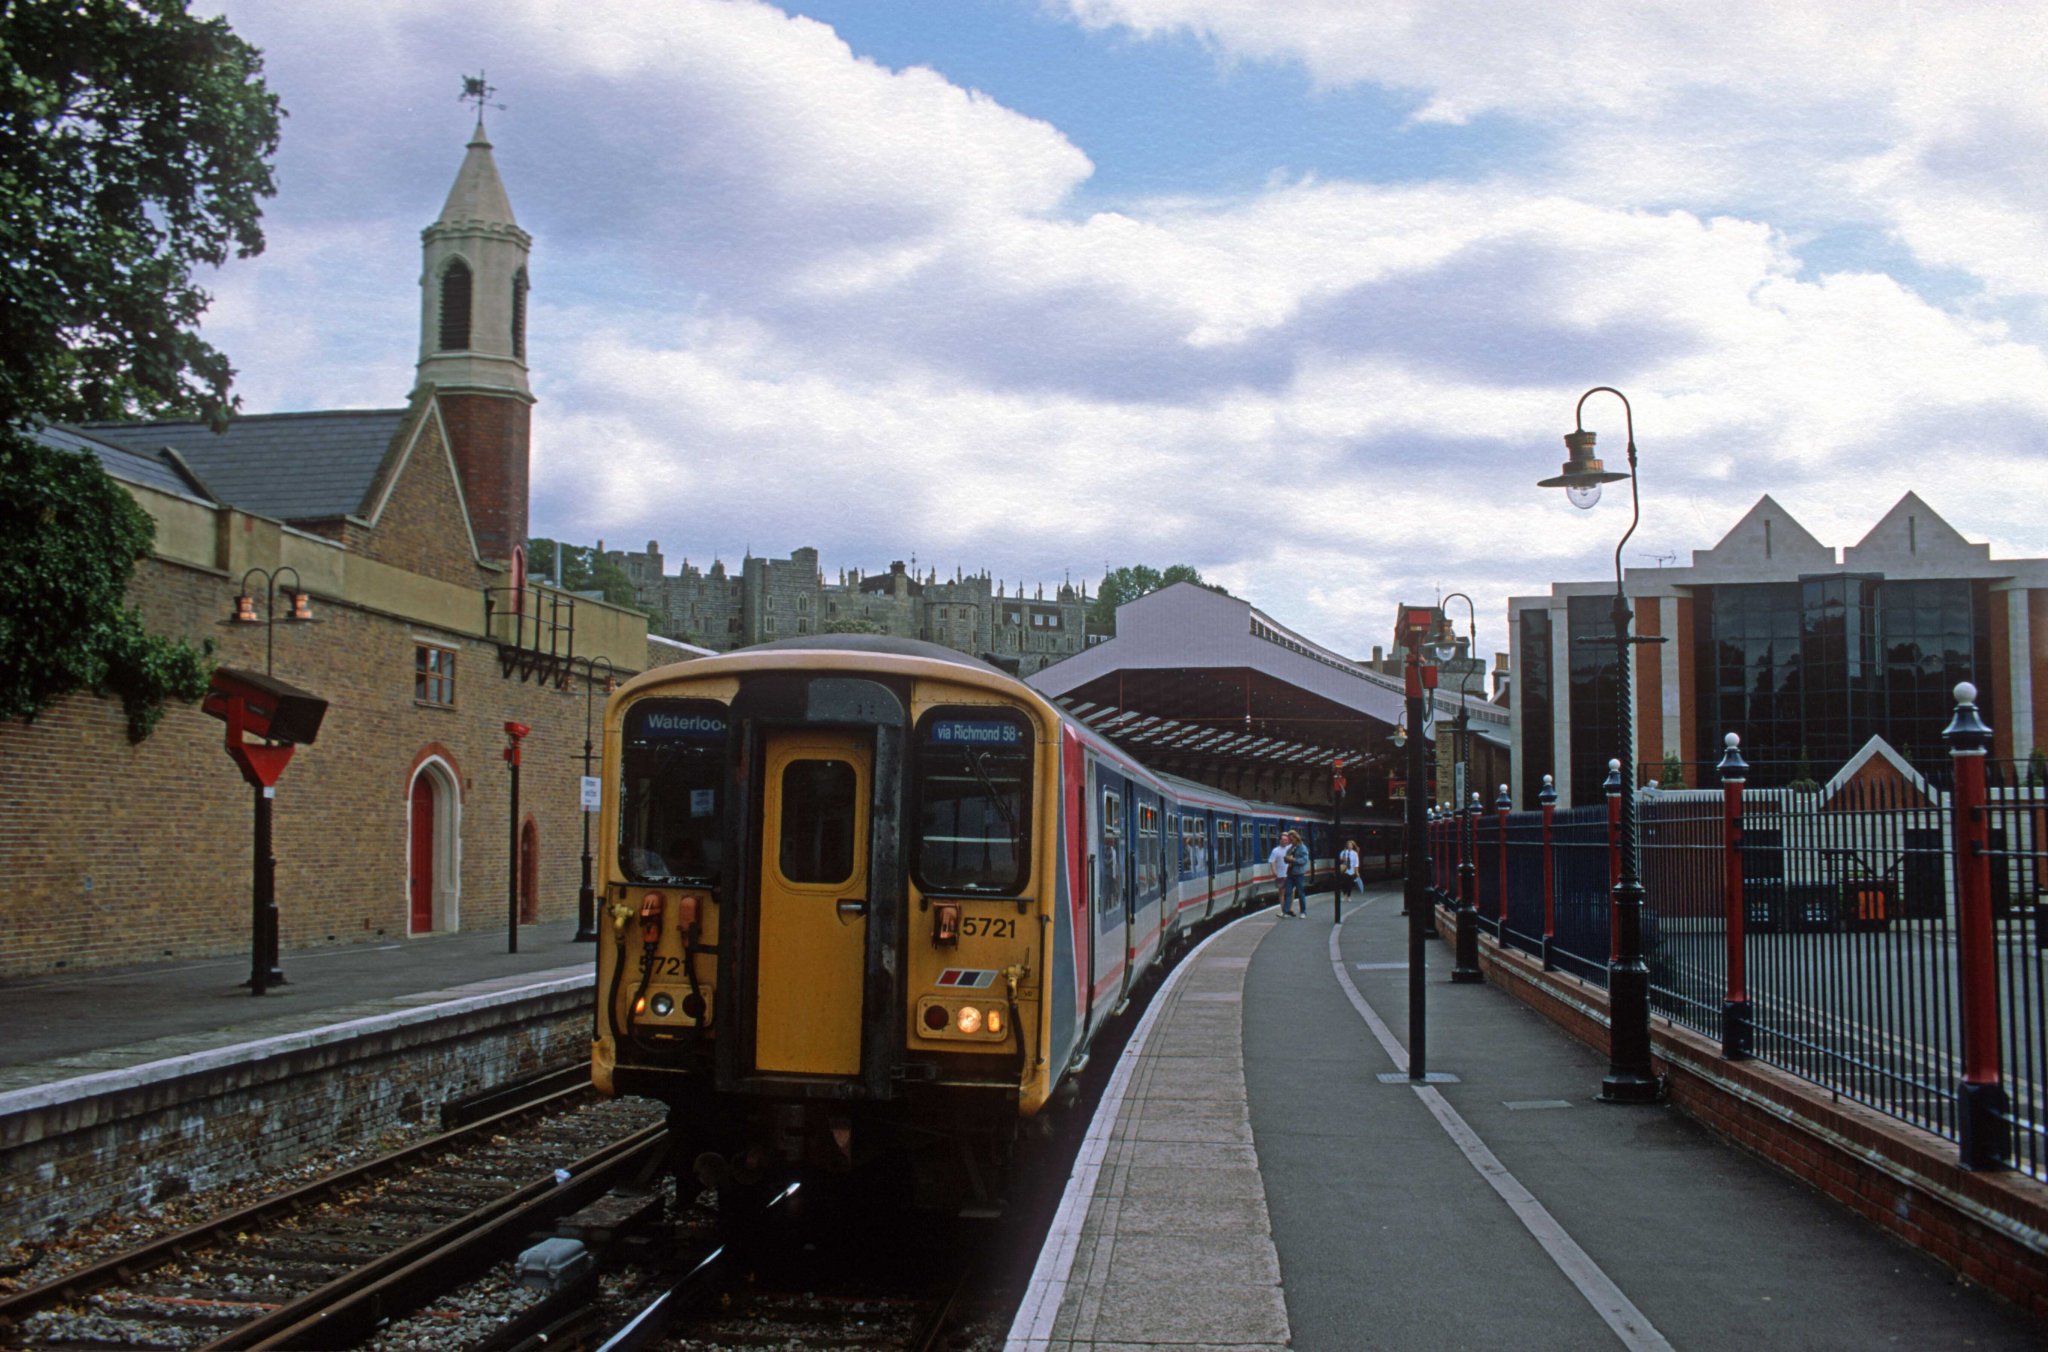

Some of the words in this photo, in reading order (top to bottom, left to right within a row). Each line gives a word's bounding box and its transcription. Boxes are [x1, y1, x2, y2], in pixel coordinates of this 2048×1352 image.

[648, 713, 722, 731] Waterloo
[937, 724, 951, 740] via
[954, 724, 1000, 741] Richmond
[1003, 725, 1016, 741] 58
[963, 917, 1016, 939] 5721
